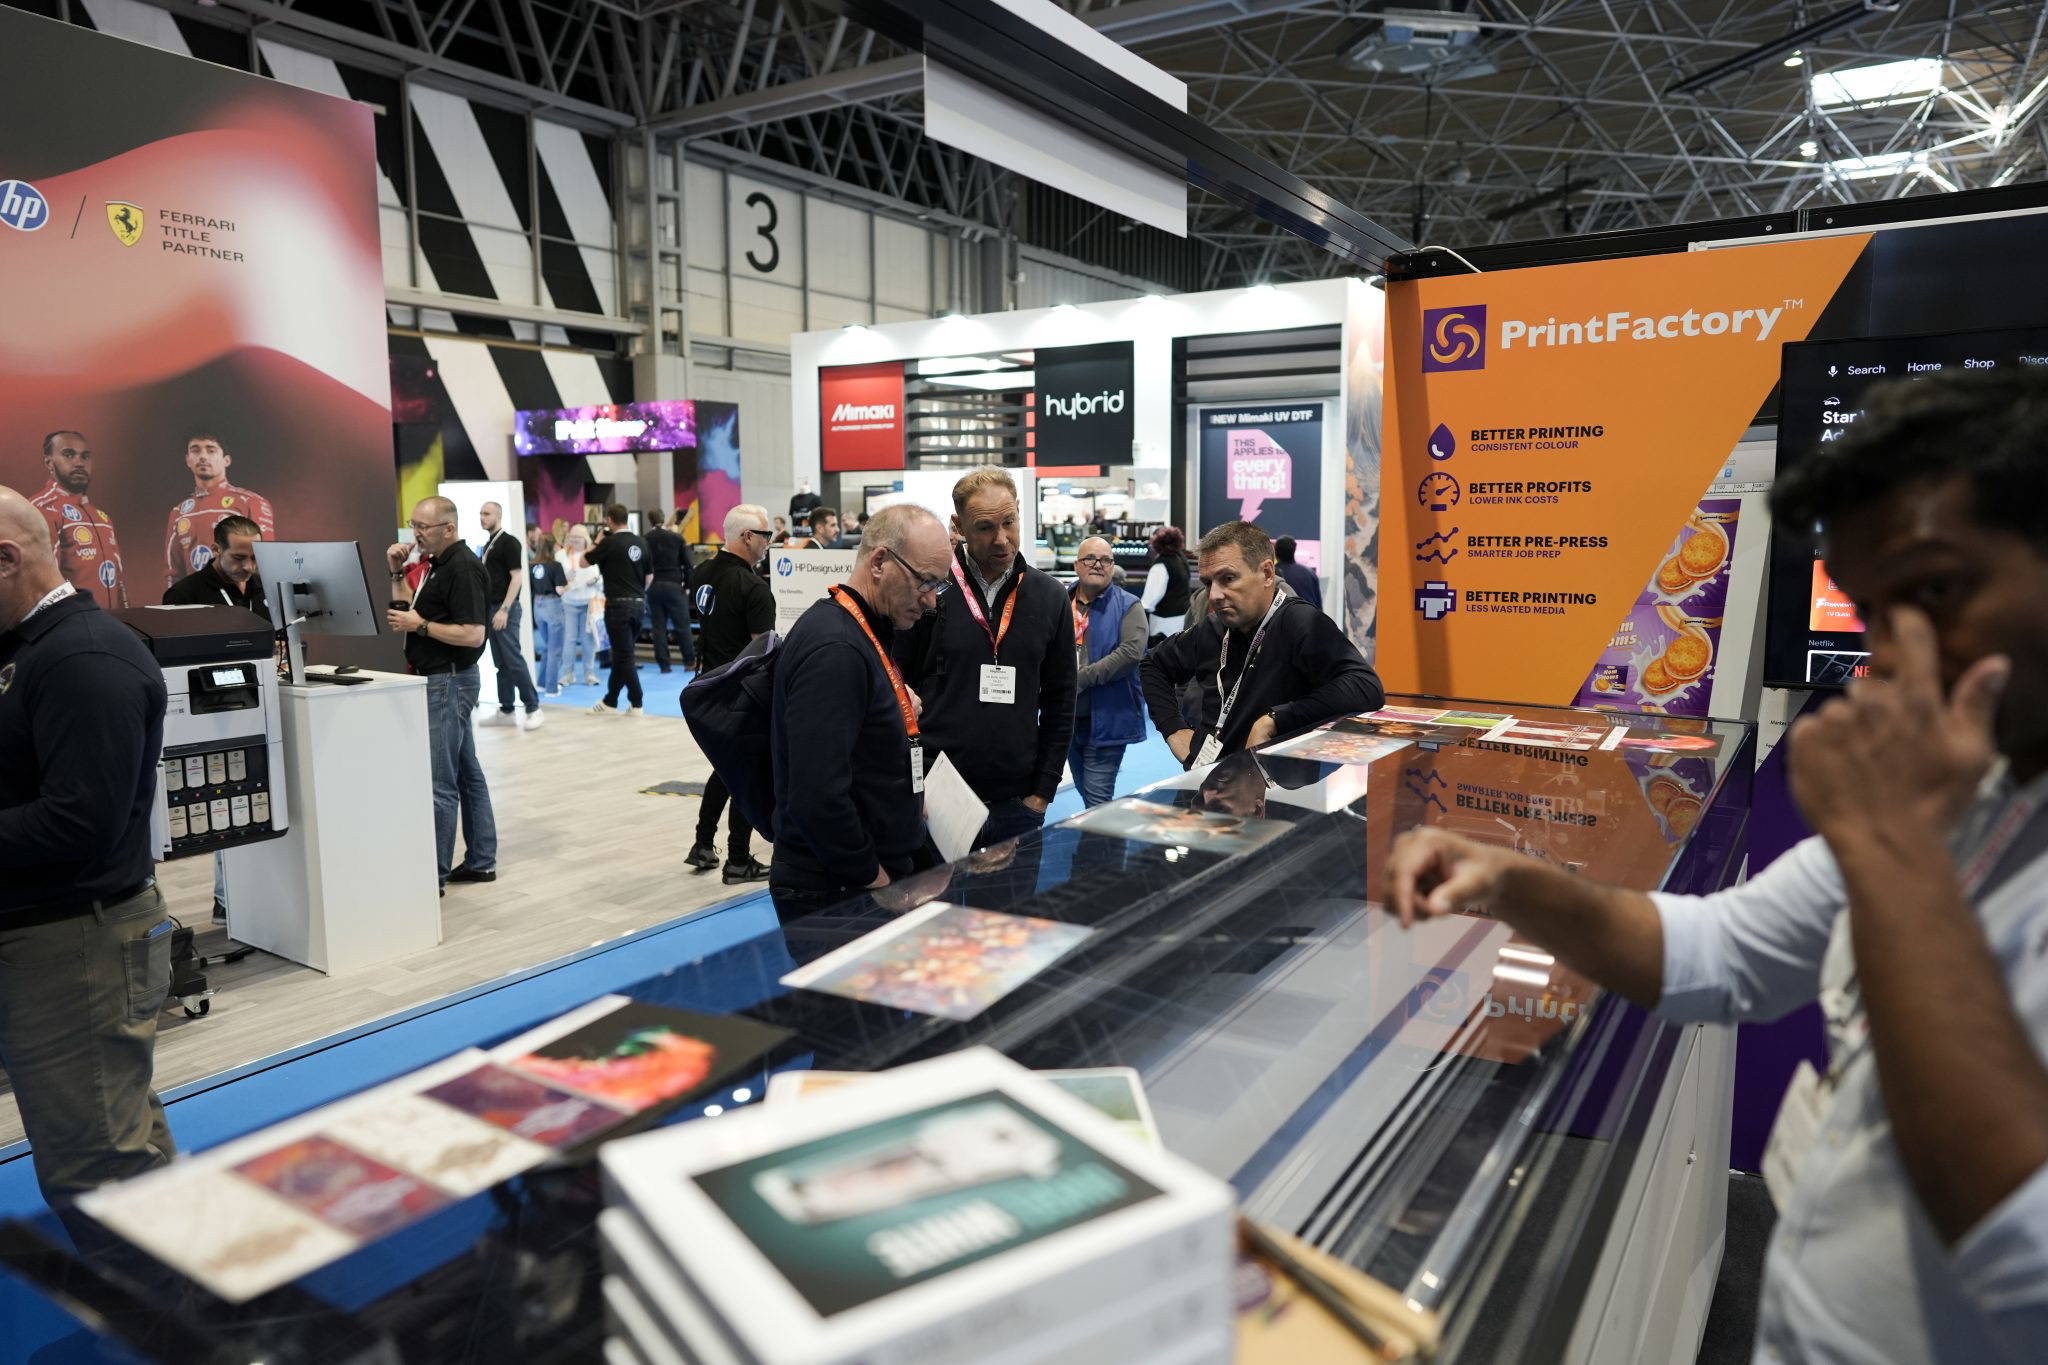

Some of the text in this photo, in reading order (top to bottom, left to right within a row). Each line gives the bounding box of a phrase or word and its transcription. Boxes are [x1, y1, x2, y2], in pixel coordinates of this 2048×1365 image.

[0, 180, 42, 229] hp
[160, 209, 235, 231] FERRARI
[161, 225, 211, 242] TITLE
[746, 191, 779, 273] 3
[163, 241, 244, 262] PARTNER
[1847, 365, 1886, 375] Search
[1907, 361, 1942, 373] Home
[1964, 359, 1995, 370] Shop
[1045, 389, 1124, 420] hybrid
[831, 403, 895, 422] Mimaki
[1210, 410, 1313, 424] NEW Mimaki UV DTF
[1471, 425, 1604, 441] BETTER PRINTING
[1234, 439, 1255, 447] THIS
[1471, 440, 1579, 452] CONSISTENT COLOUR
[1233, 447, 1273, 456] APPLIES
[1233, 459, 1285, 474] every
[1233, 472, 1286, 493] thing!
[1469, 481, 1591, 494] BETTER PROFITS
[1469, 495, 1559, 505] LOWER INK COSTS
[1467, 536, 1608, 548] BETTER PRE-PRESS
[1467, 550, 1561, 558] SMARTER JOB PREP
[778, 558, 792, 576] hp
[795, 564, 806, 572] HP
[807, 563, 844, 574] DesignJet
[1466, 591, 1597, 605] BETTER PRINTING
[1466, 605, 1566, 615] LESS WASTED MEDIA
[1808, 640, 1835, 648] Netflix
